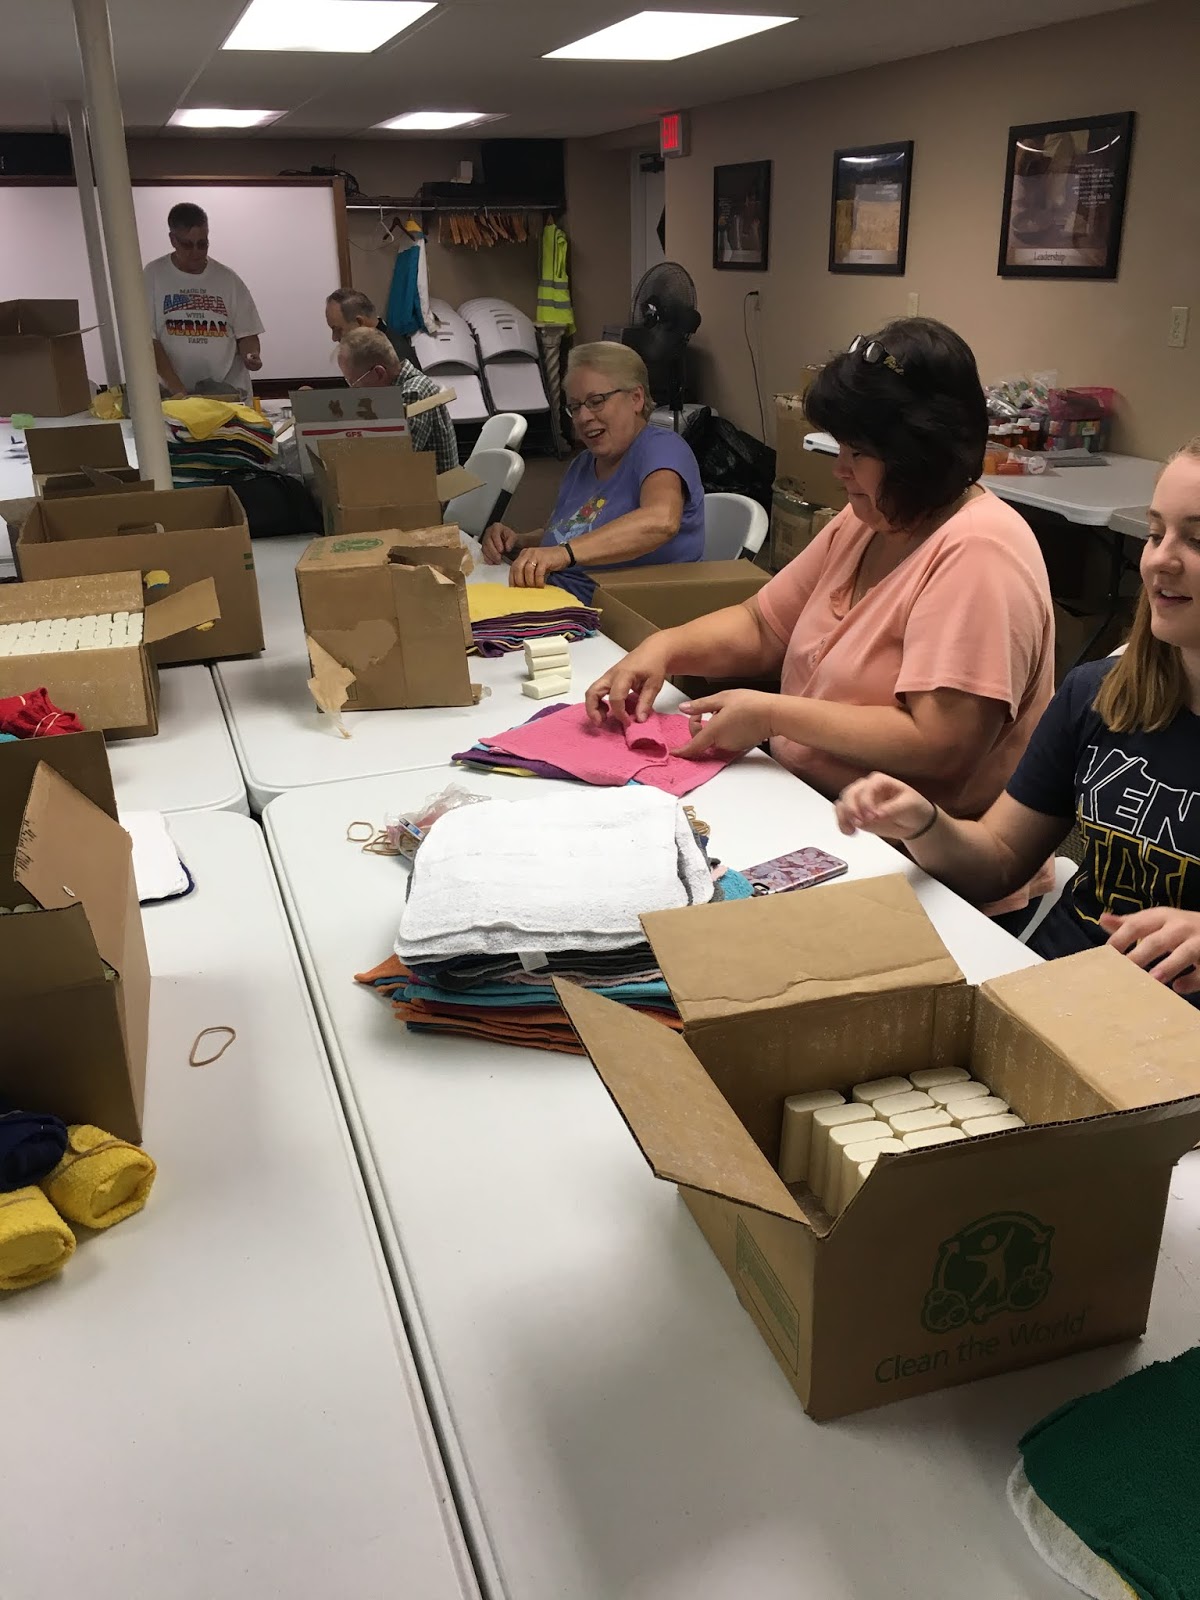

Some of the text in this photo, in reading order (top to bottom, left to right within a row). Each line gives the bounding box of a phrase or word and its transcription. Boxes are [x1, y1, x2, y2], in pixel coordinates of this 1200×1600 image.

[663, 114, 679, 149] EXIT
[1033, 251, 1067, 265] Leadership
[163, 294, 228, 317] AMERICA
[166, 319, 229, 337] GERMAN
[874, 1310, 1087, 1384] Clean the World
